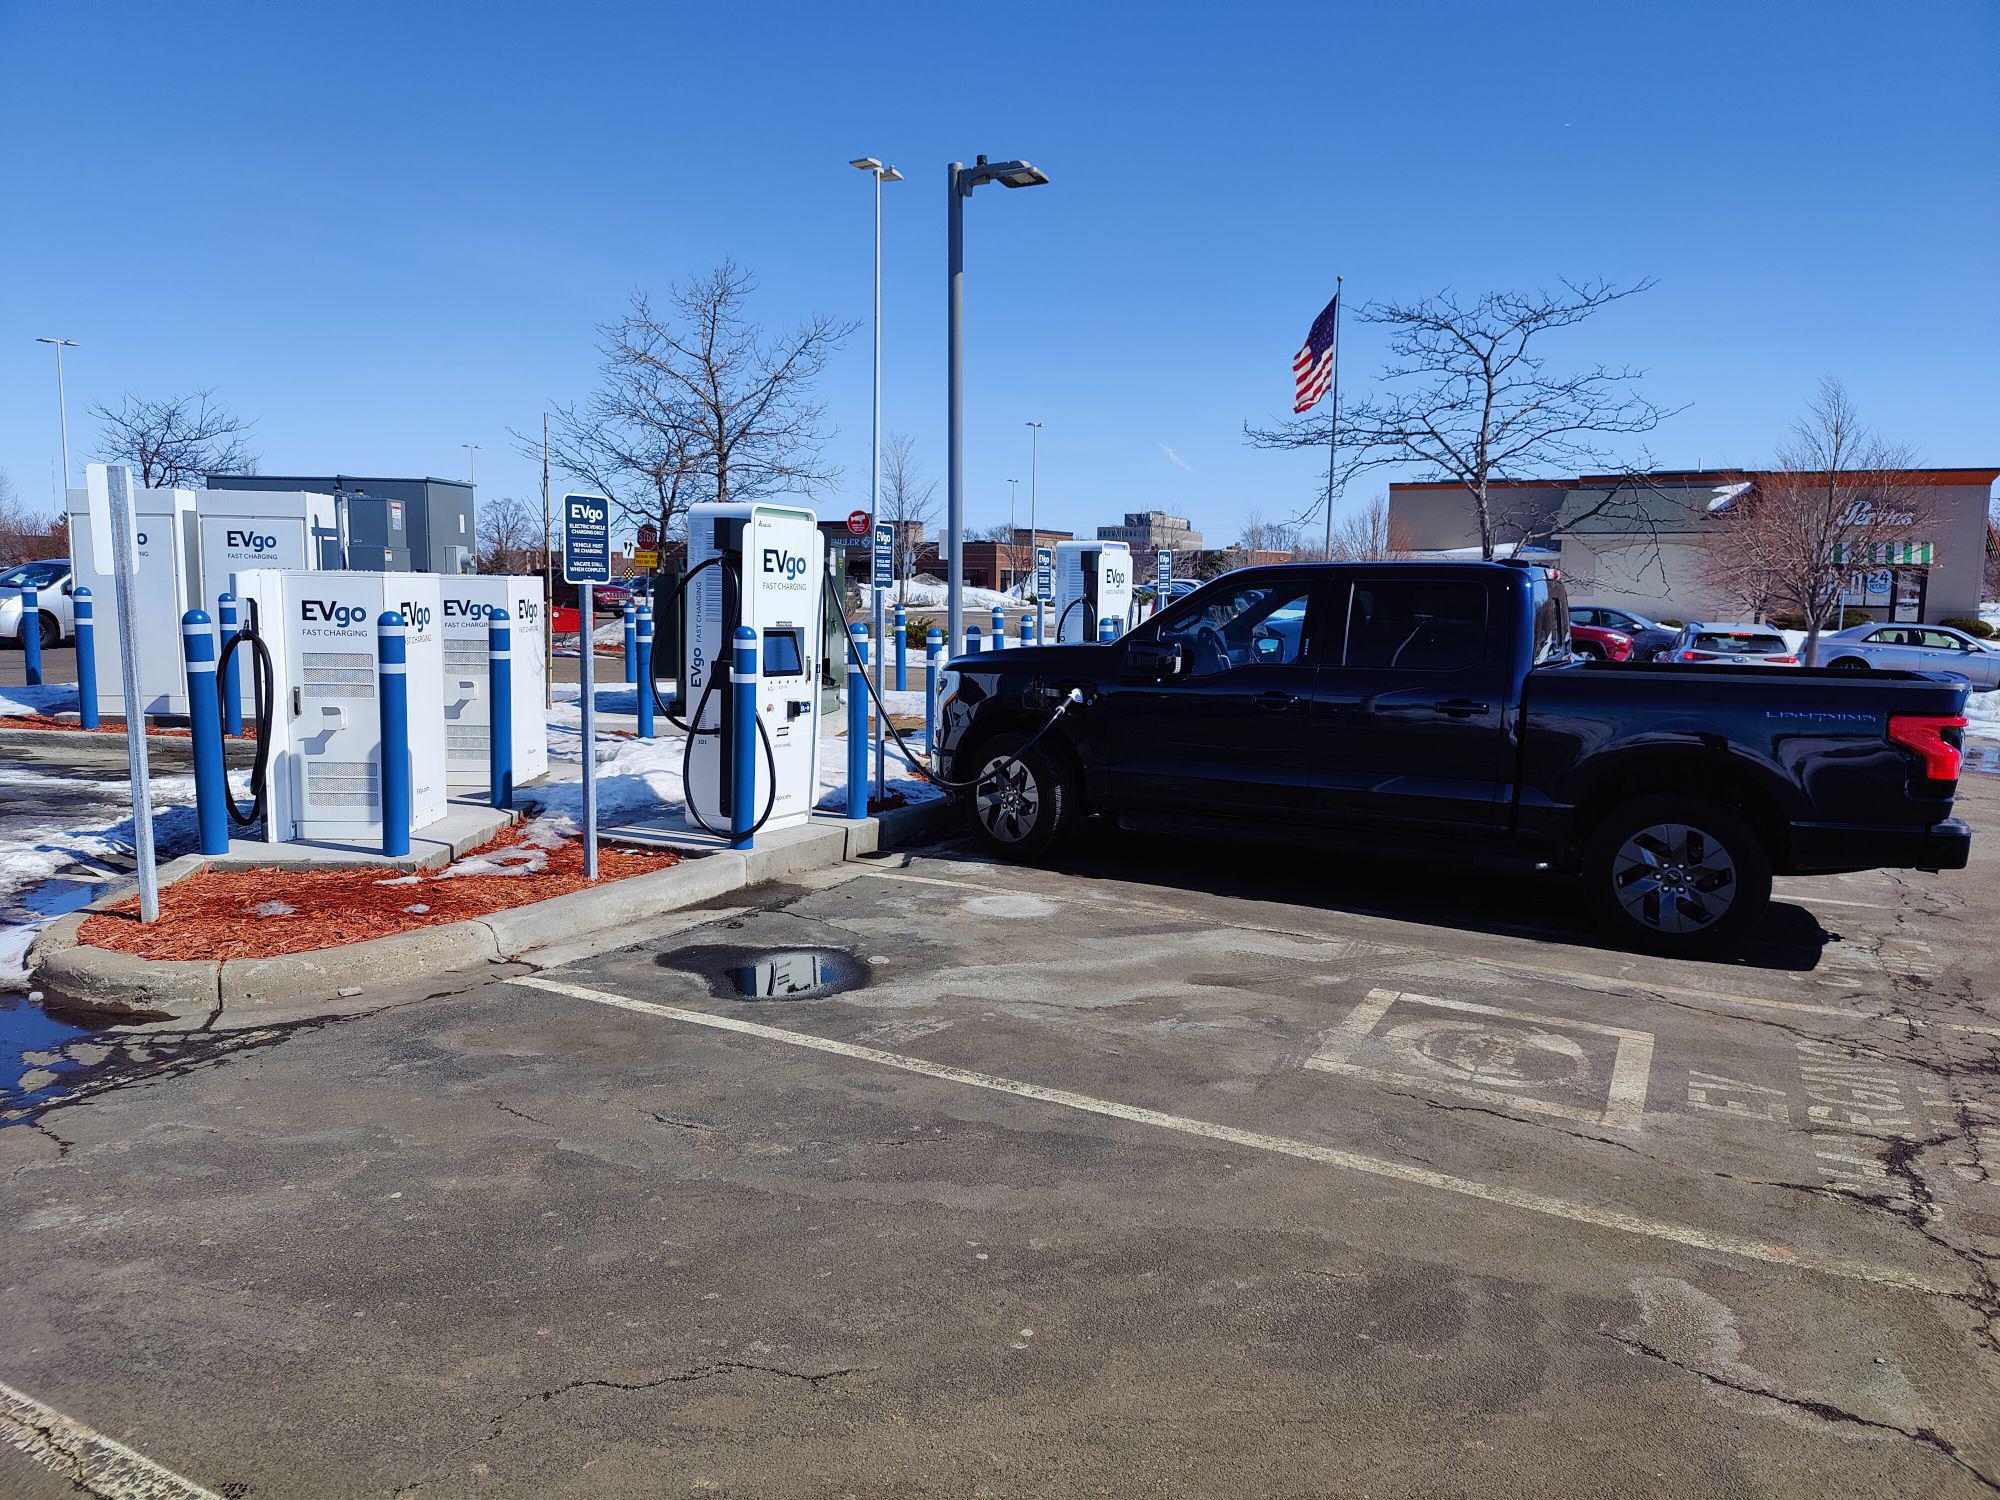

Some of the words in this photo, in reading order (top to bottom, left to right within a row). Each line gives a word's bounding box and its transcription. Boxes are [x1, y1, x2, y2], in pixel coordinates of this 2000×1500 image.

[571, 504, 604, 523] EVgo
[1837, 500, 1912, 526] Perins
[227, 531, 277, 552] EVgo
[763, 549, 806, 580] EVgo
[763, 582, 777, 590] FAST
[778, 583, 807, 591] CHARGING
[1106, 569, 1125, 588] EVgo
[1869, 571, 1889, 584] 24
[302, 600, 365, 627] EVgo
[401, 601, 431, 632] EVgo
[443, 600, 493, 621] EVgo
[519, 599, 537, 623] EVgo
[302, 628, 322, 636] FAST
[691, 647, 704, 688] EVgo
